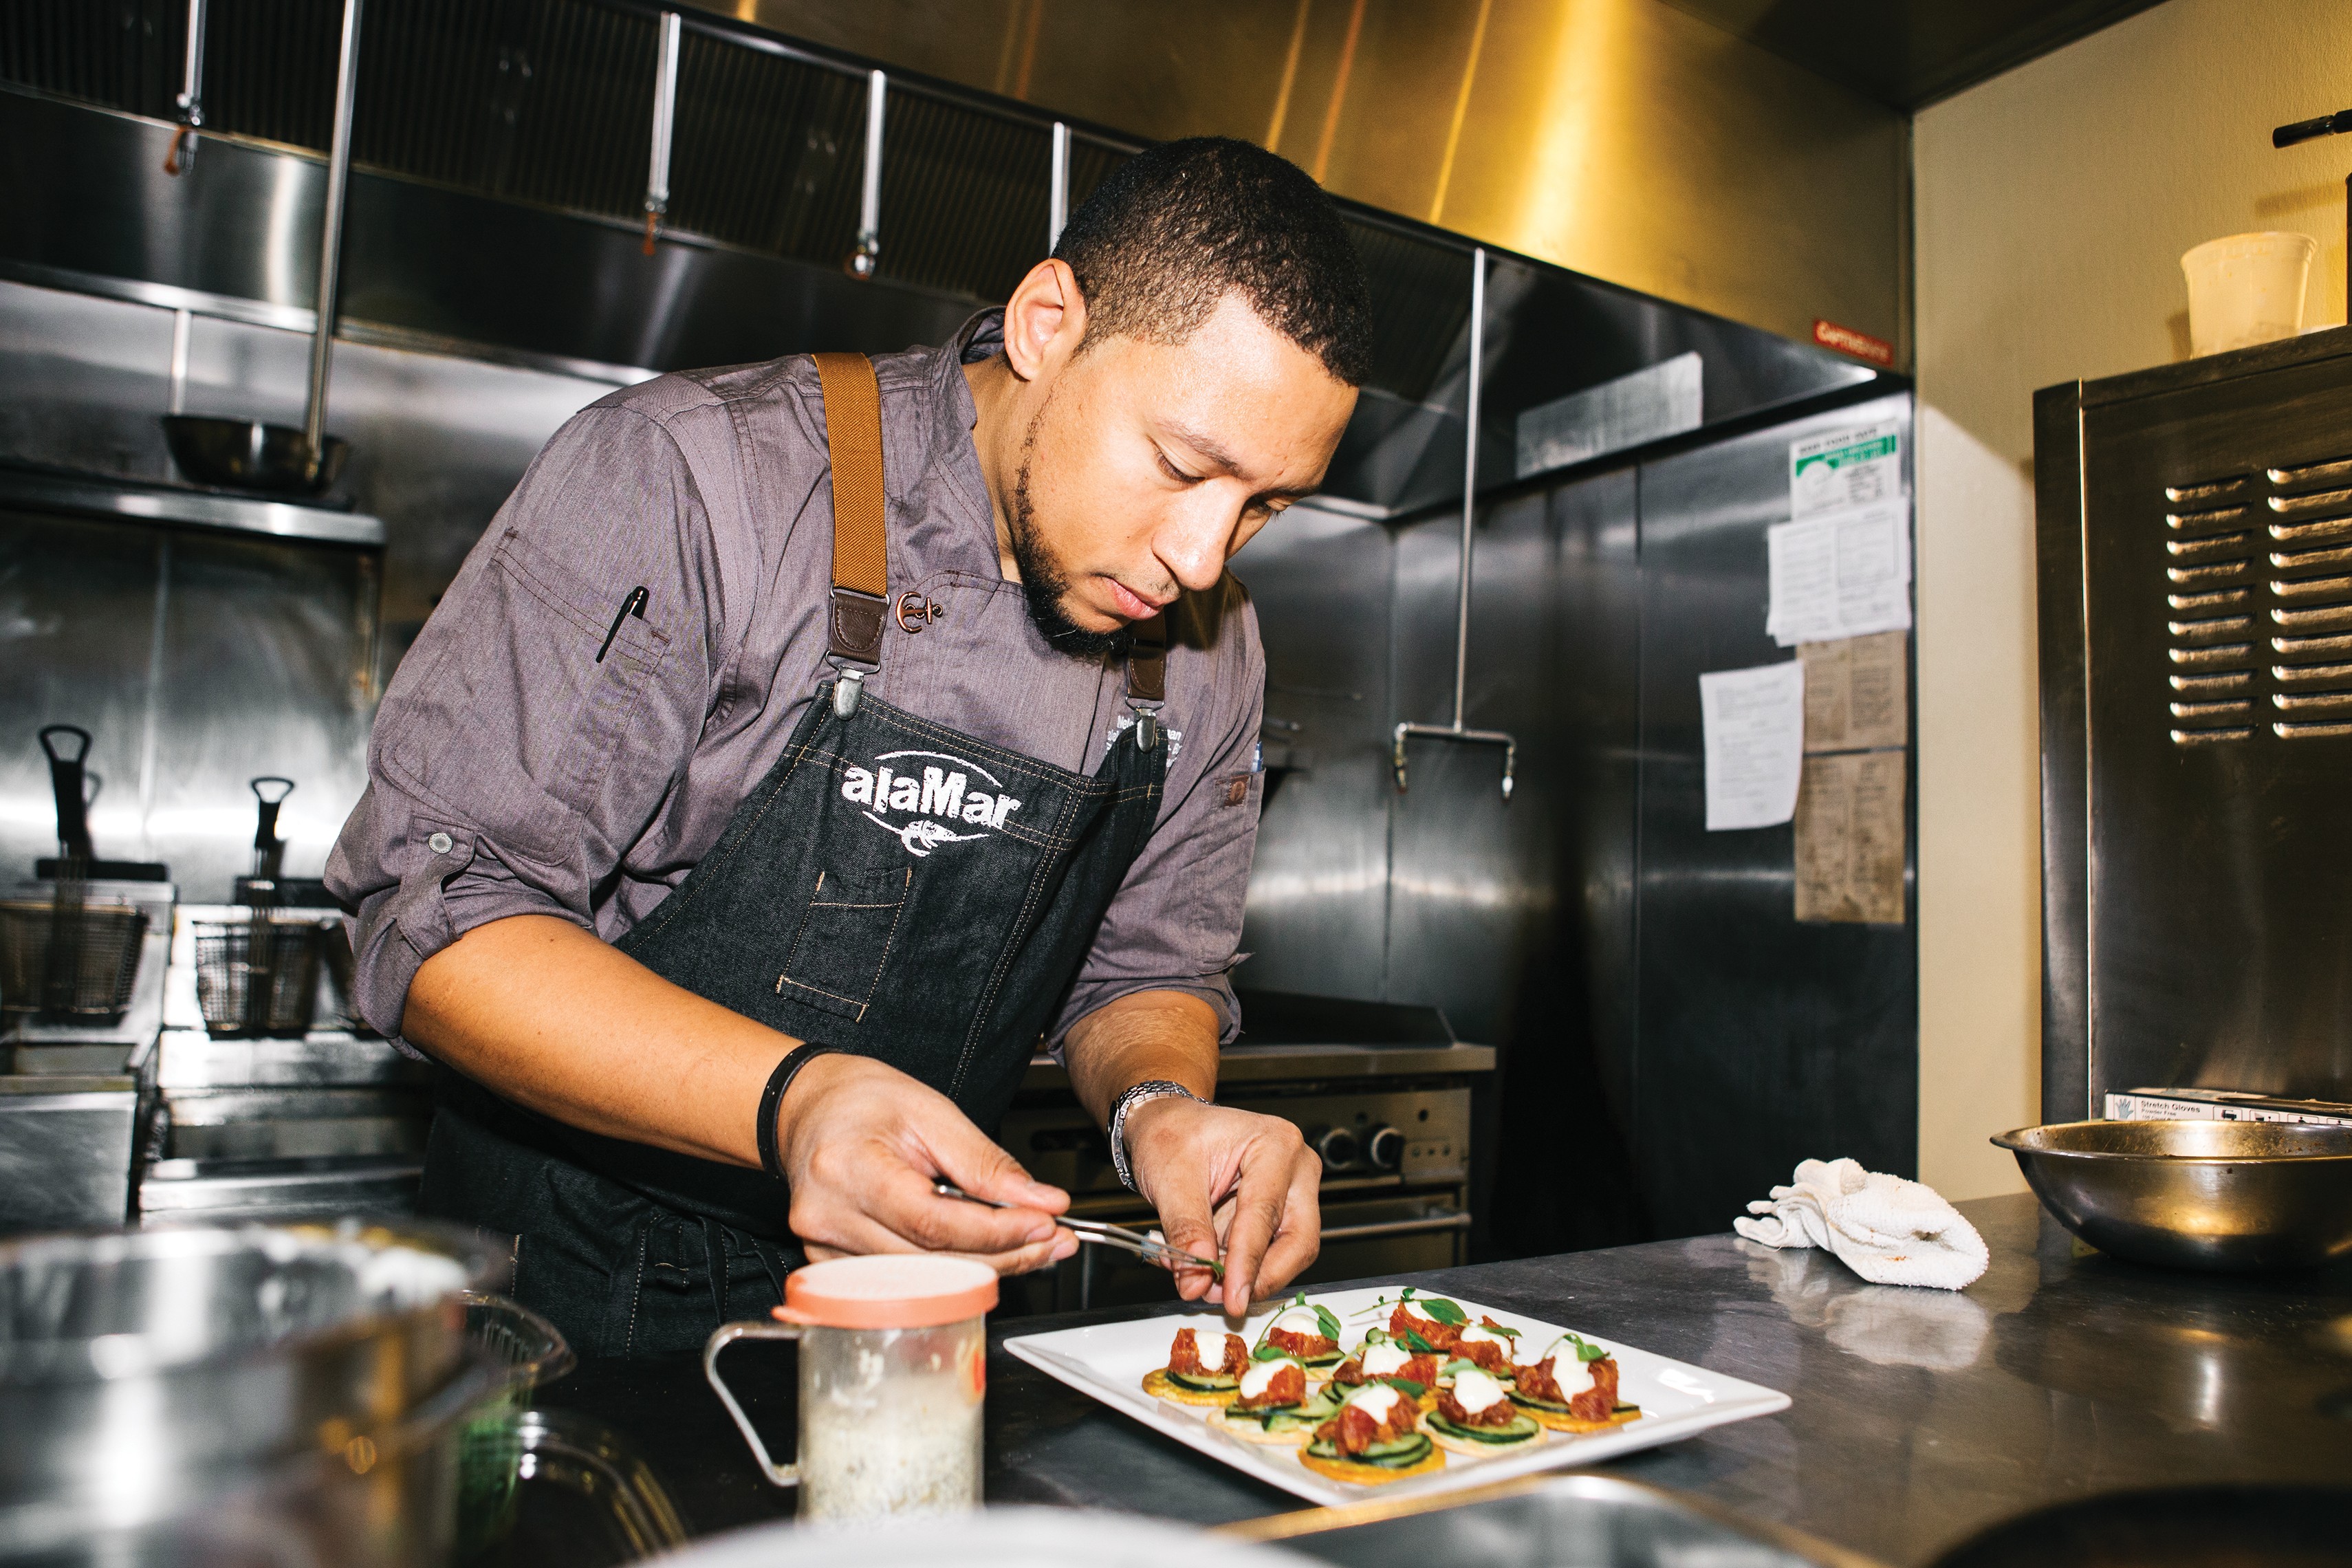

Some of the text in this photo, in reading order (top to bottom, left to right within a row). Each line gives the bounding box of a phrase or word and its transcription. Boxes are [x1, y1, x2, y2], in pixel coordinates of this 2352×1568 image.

[841, 765, 1022, 830] alaMar
[2141, 1100, 2201, 1113] Stretch Gloves
